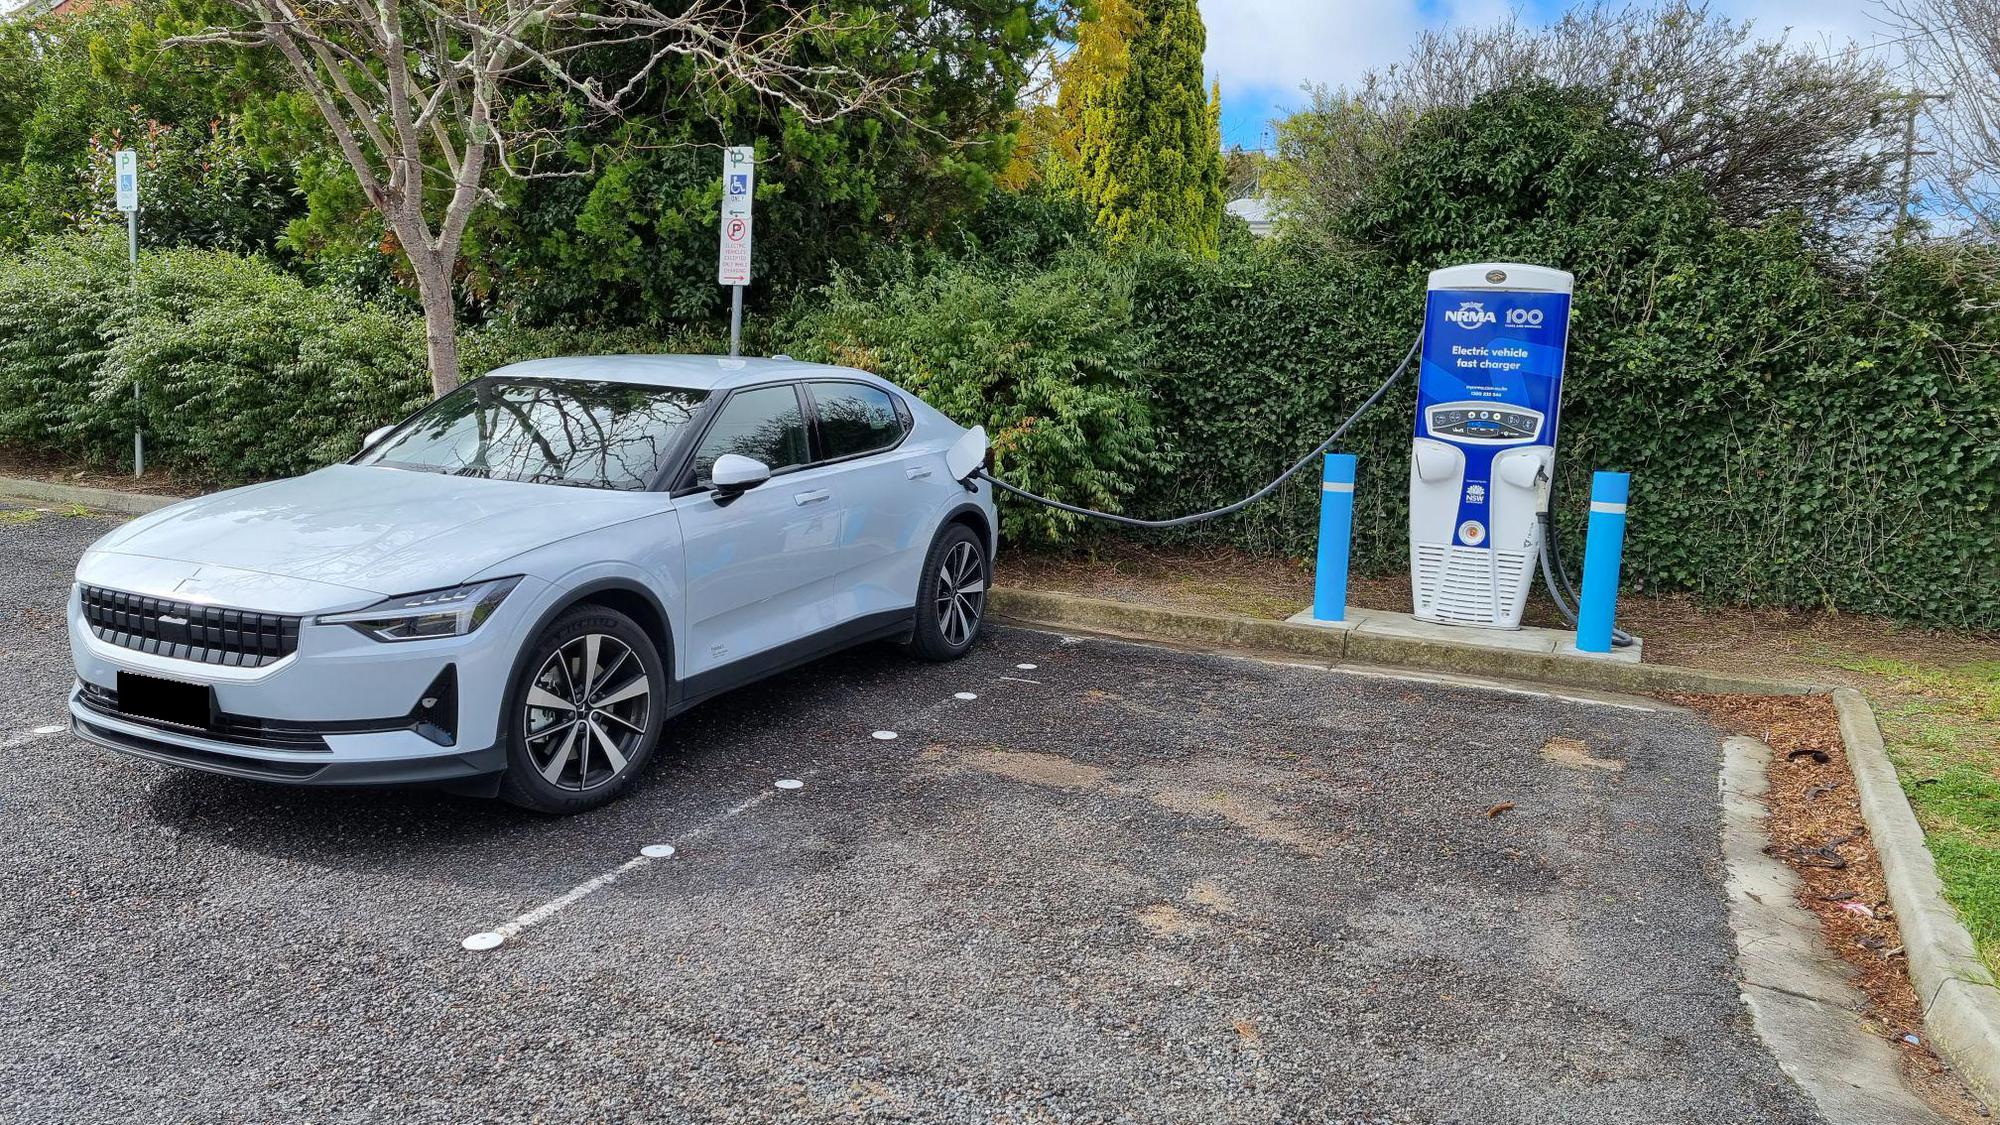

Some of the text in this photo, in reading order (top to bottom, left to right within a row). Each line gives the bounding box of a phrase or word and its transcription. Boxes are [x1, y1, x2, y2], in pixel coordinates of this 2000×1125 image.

[121, 156, 129, 170] P
[1445, 308, 1544, 325] NRMA 100
[1452, 345, 1529, 358] Electric vehicle
[1456, 358, 1521, 371] fast charger
[1466, 494, 1484, 502] NSW
